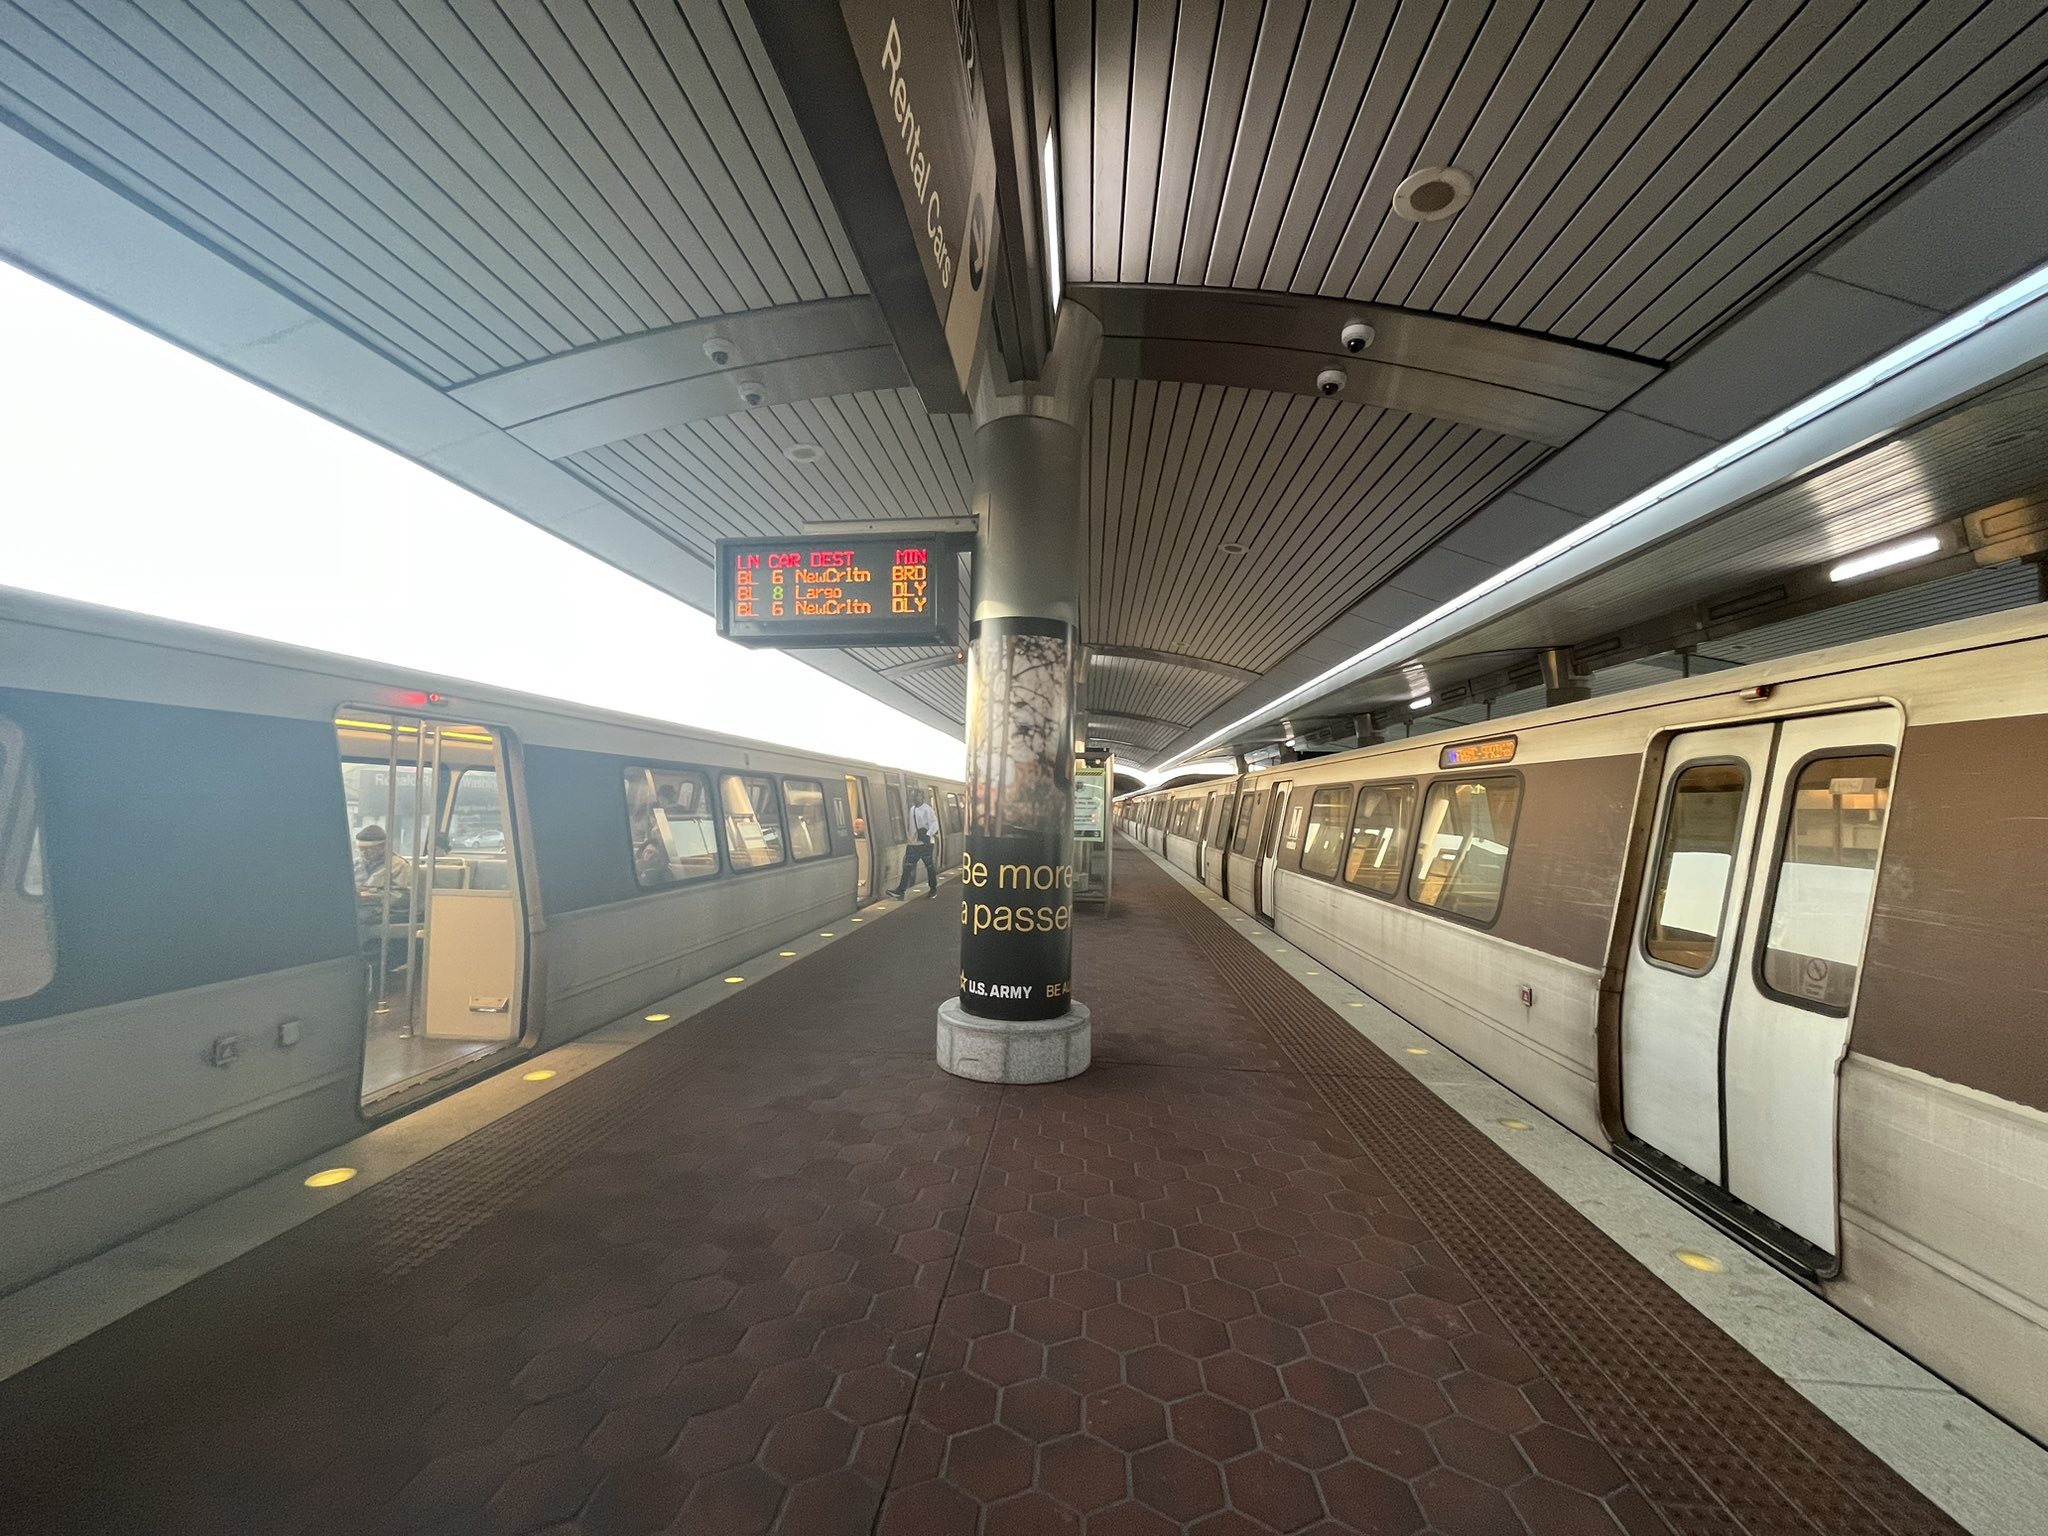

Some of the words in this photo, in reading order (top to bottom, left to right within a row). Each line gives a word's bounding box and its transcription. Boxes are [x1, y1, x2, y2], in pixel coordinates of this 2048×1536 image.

[880, 17, 930, 205] Rental
[927, 190, 950, 289] Cars
[737, 555, 761, 569] LN
[768, 553, 801, 569] CAR
[810, 551, 855, 567] DEST
[895, 549, 927, 565] MIN
[737, 571, 759, 585] BL
[771, 570, 784, 584] 6
[892, 565, 927, 581] BRD
[737, 586, 759, 601] BL
[772, 586, 784, 600] 8
[795, 585, 843, 600] Largo
[892, 582, 927, 597] DLY
[737, 602, 759, 617] BL
[771, 601, 784, 616] 6
[892, 597, 927, 613] DLY
[962, 852, 988, 887] Be
[1000, 865, 1073, 890] more
[961, 900, 968, 925] a
[969, 980, 988, 996] U.S.
[990, 984, 1033, 999] ARMY
[1046, 984, 1061, 998] BE
